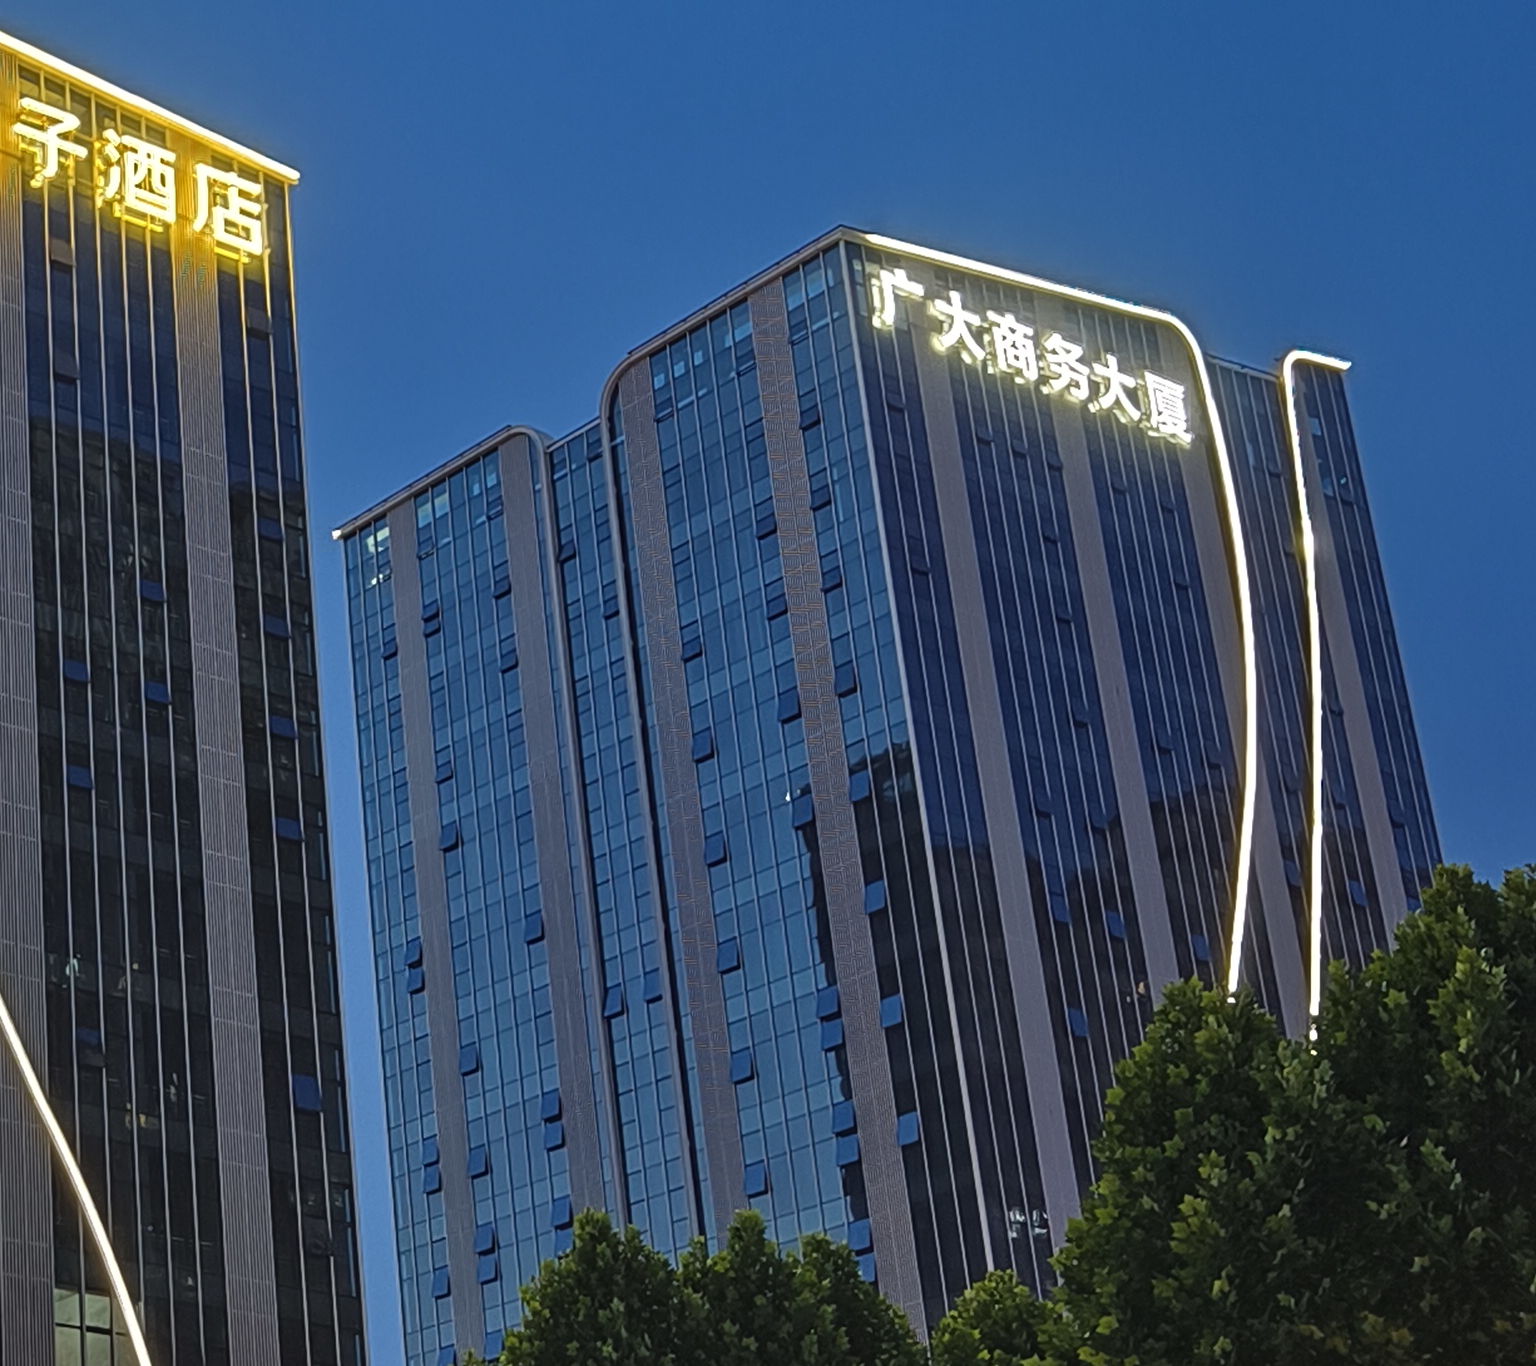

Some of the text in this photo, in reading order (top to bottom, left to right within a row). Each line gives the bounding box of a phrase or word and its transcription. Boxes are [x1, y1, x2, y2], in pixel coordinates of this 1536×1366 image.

[872, 268, 1194, 448] 广大商务大厦
